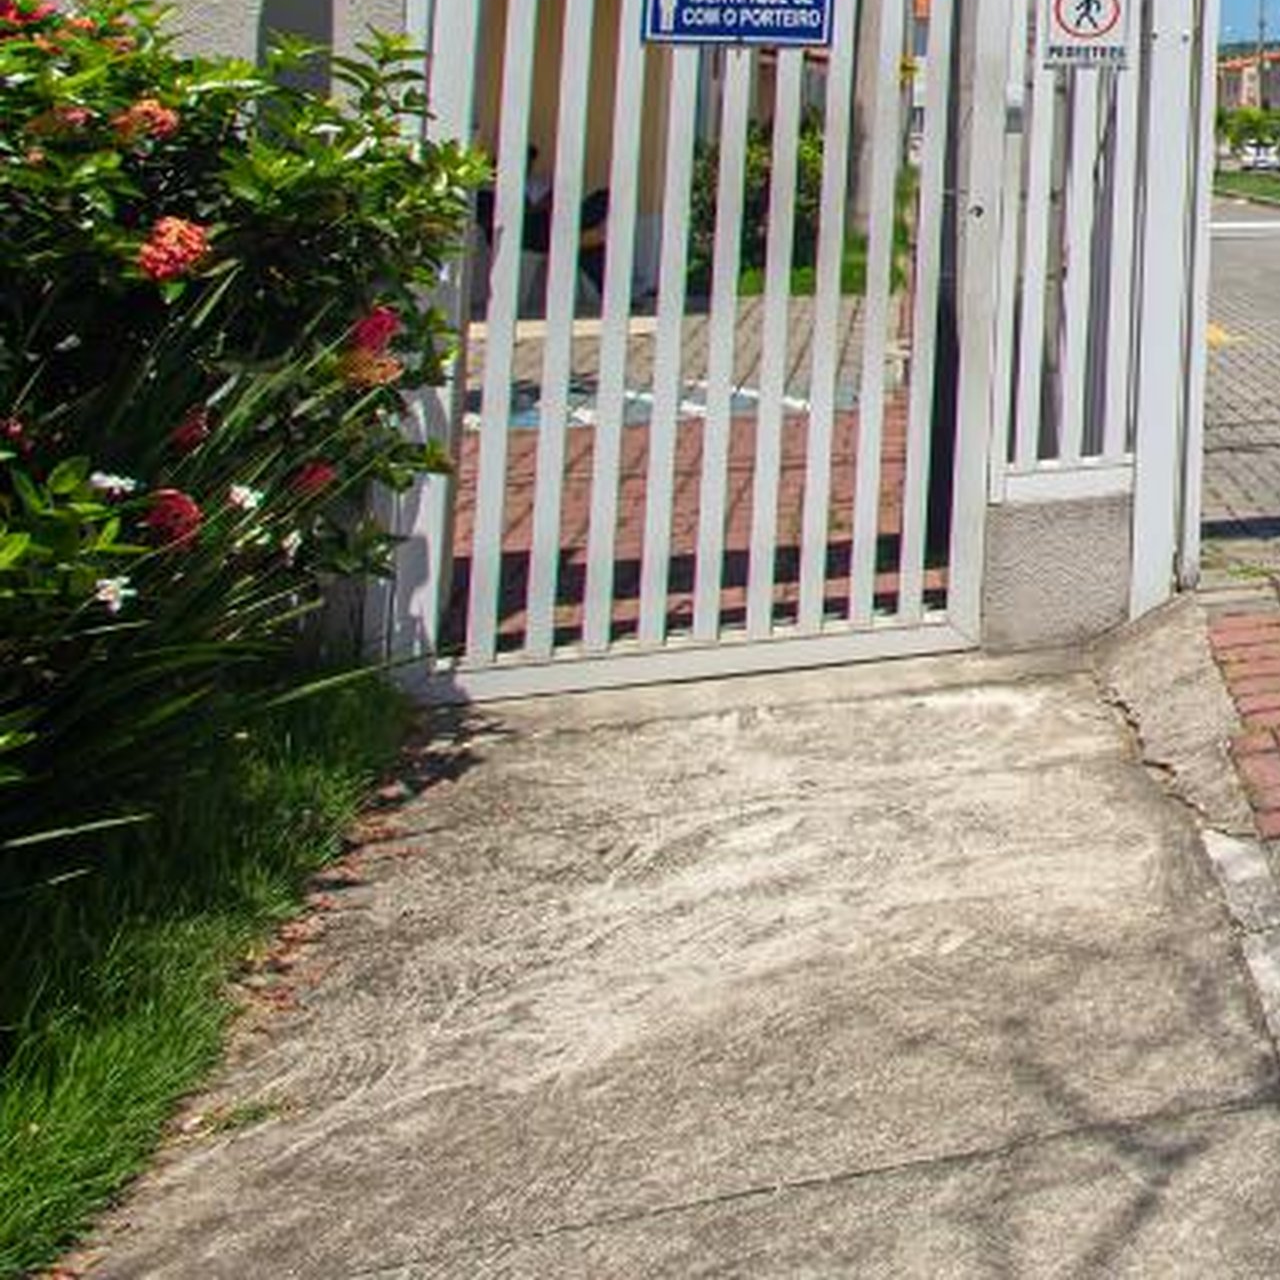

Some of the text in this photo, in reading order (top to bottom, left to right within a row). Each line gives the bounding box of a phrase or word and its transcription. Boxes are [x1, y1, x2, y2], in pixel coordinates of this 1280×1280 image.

[682, 9, 821, 28] COM O PORTEIRO
